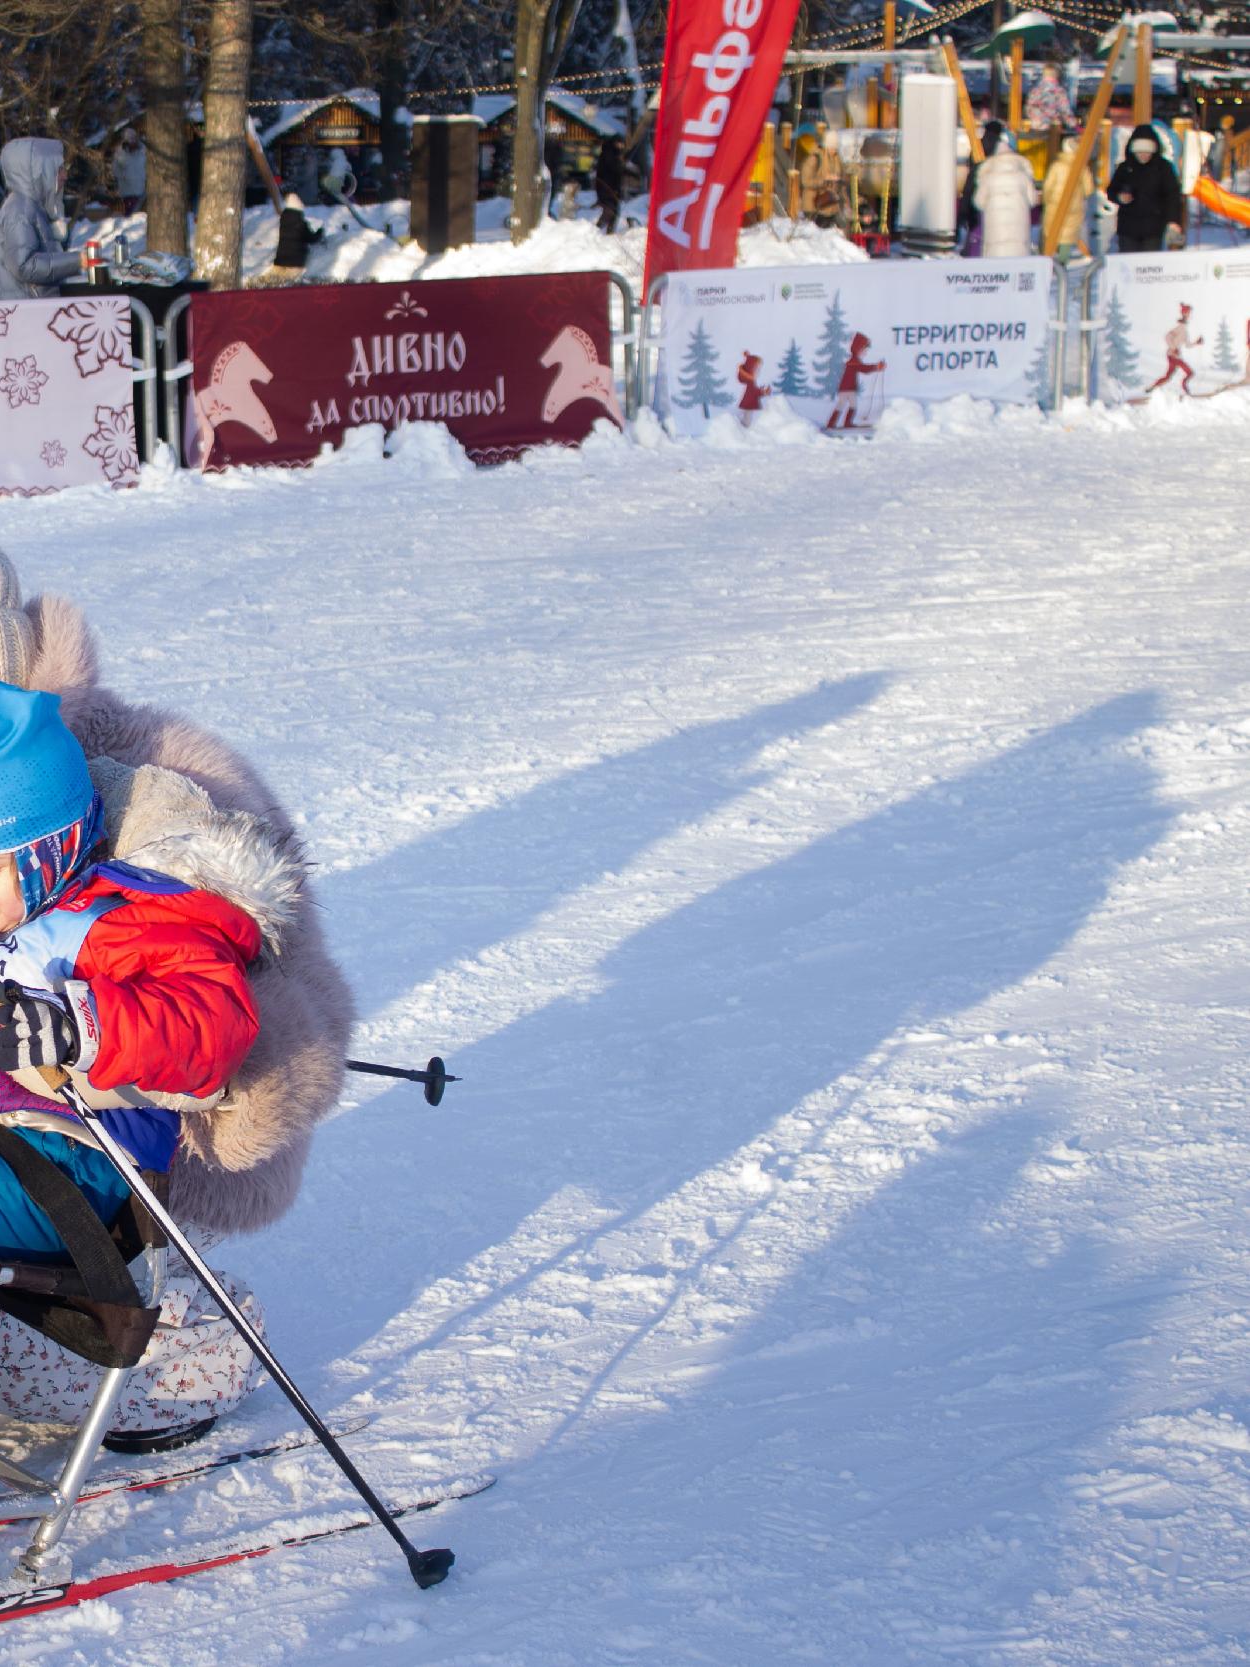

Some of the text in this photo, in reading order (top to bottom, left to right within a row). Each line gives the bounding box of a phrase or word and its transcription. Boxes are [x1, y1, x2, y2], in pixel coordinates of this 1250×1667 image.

[946, 272, 1011, 285] УРАЛХИМ
[696, 286, 727, 296] ПАРКИ
[891, 321, 1027, 346] ТЕРРИТОРИЯ
[345, 331, 467, 388] ДИВНО
[915, 350, 999, 372] СПОРТА
